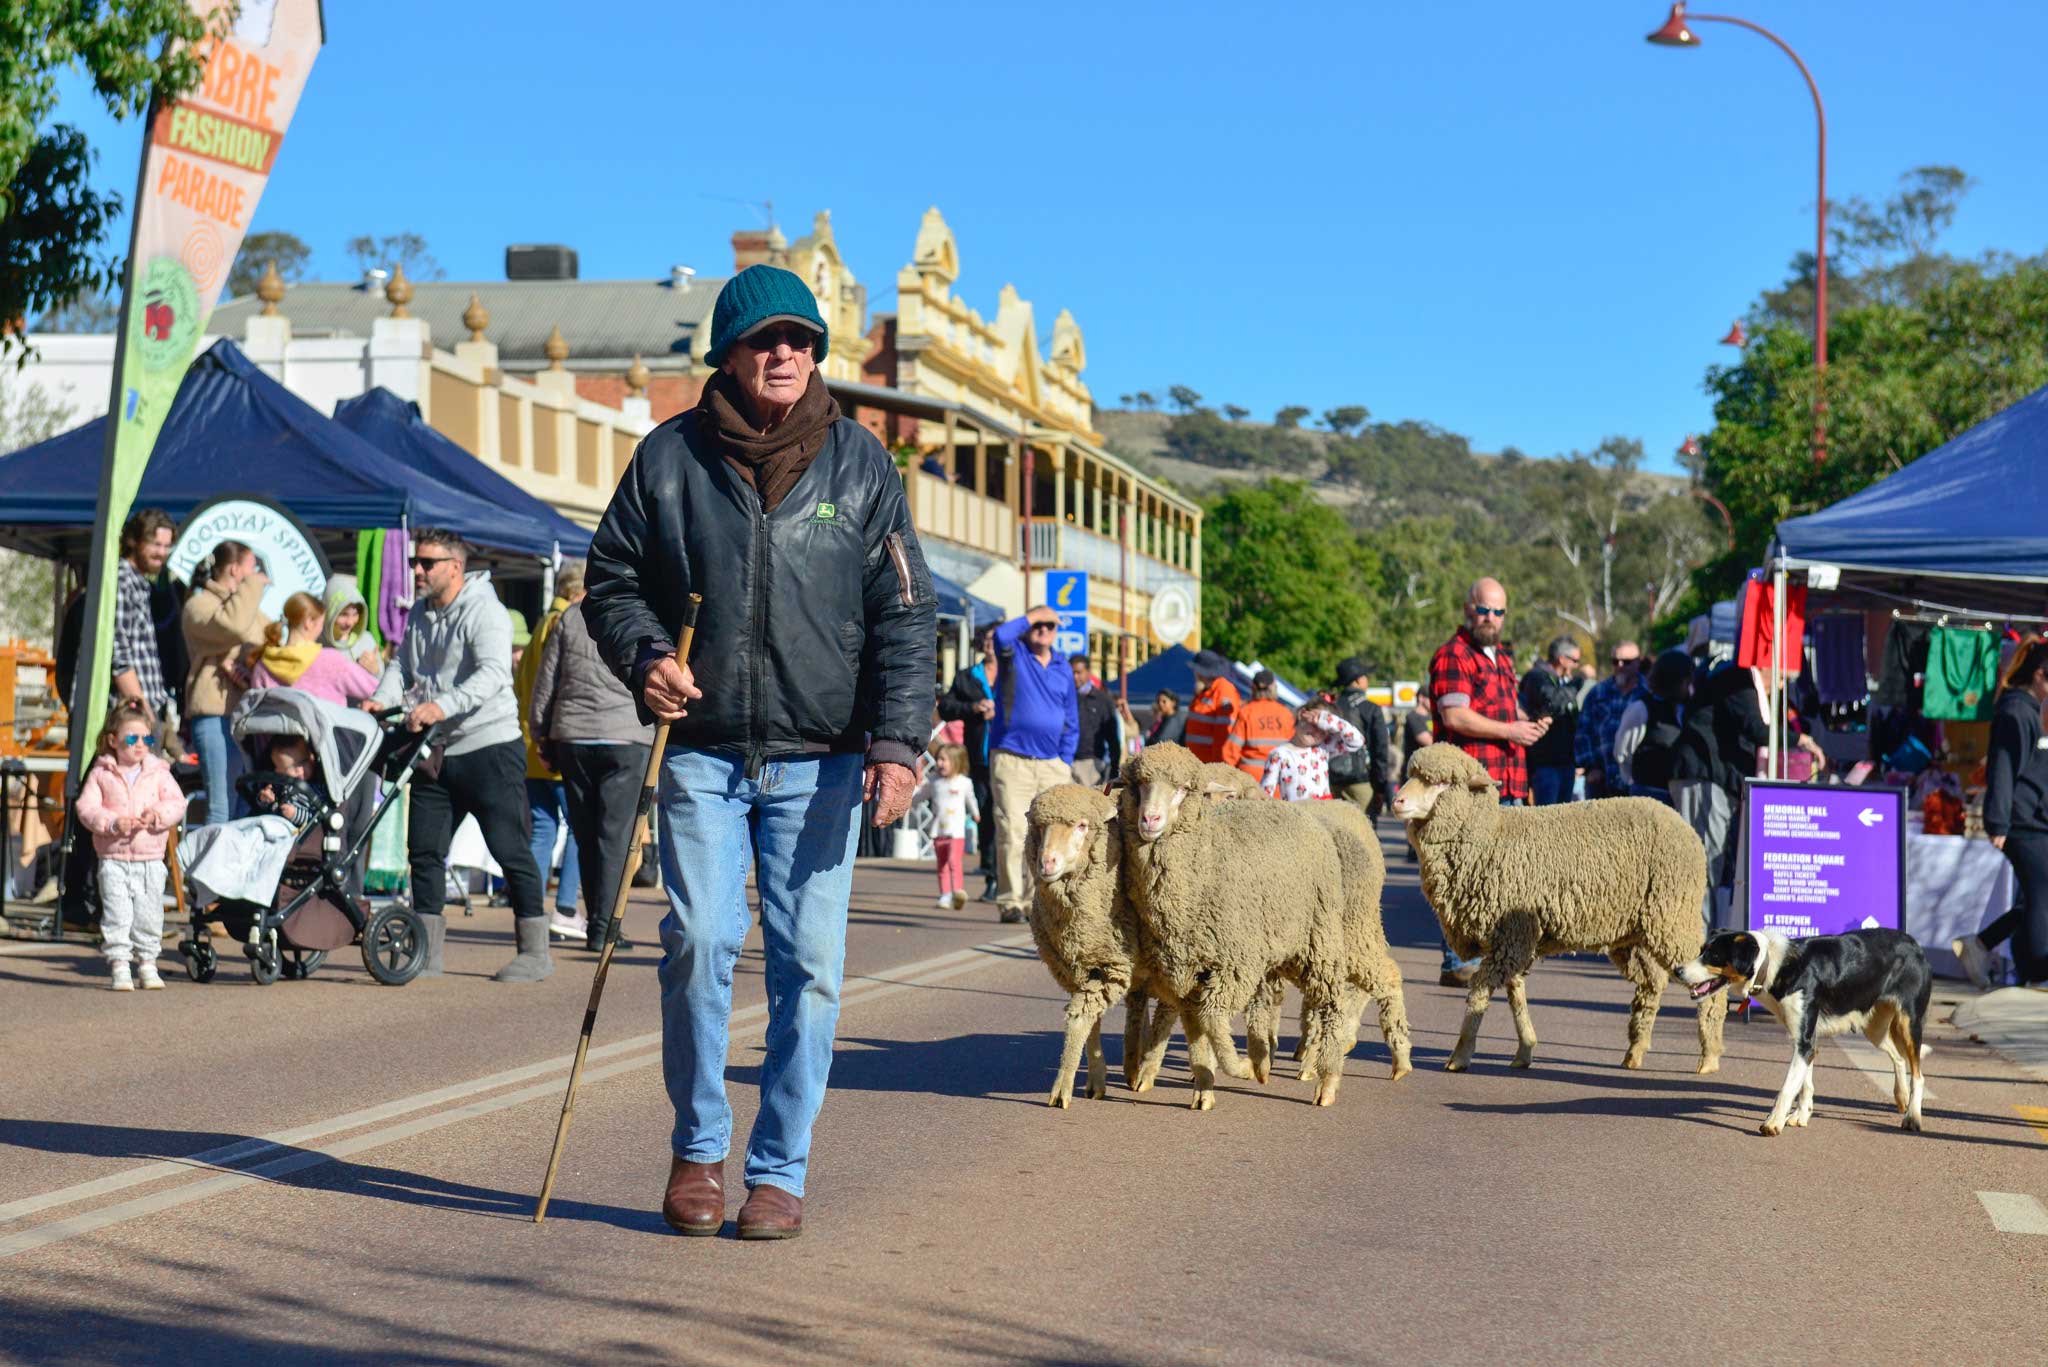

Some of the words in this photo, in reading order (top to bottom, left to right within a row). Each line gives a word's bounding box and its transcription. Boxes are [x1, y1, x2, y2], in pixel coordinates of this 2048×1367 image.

[169, 106, 271, 171] FASHION
[158, 154, 246, 229] PARADE
[273, 529, 323, 593] SPINN
[1257, 715, 1283, 731] SES
[1763, 804, 1805, 815] MEMORIAL
[1807, 806, 1828, 817] HALL
[1789, 822, 1819, 831] SHOWCASE
[1763, 829, 1790, 838] SPINNING
[1763, 852, 1811, 864] FEDERATION
[1813, 854, 1845, 866] SQUARE
[1763, 863, 1801, 871] INFORMATION
[1795, 871, 1817, 879] TICKETS
[1763, 893, 1796, 903] CHILDREN'S
[1797, 894, 1827, 904] ACTIVITIES
[1763, 914, 1774, 924] ST
[1775, 914, 1811, 926] STEPHEN
[1800, 926, 1820, 937] HALL
